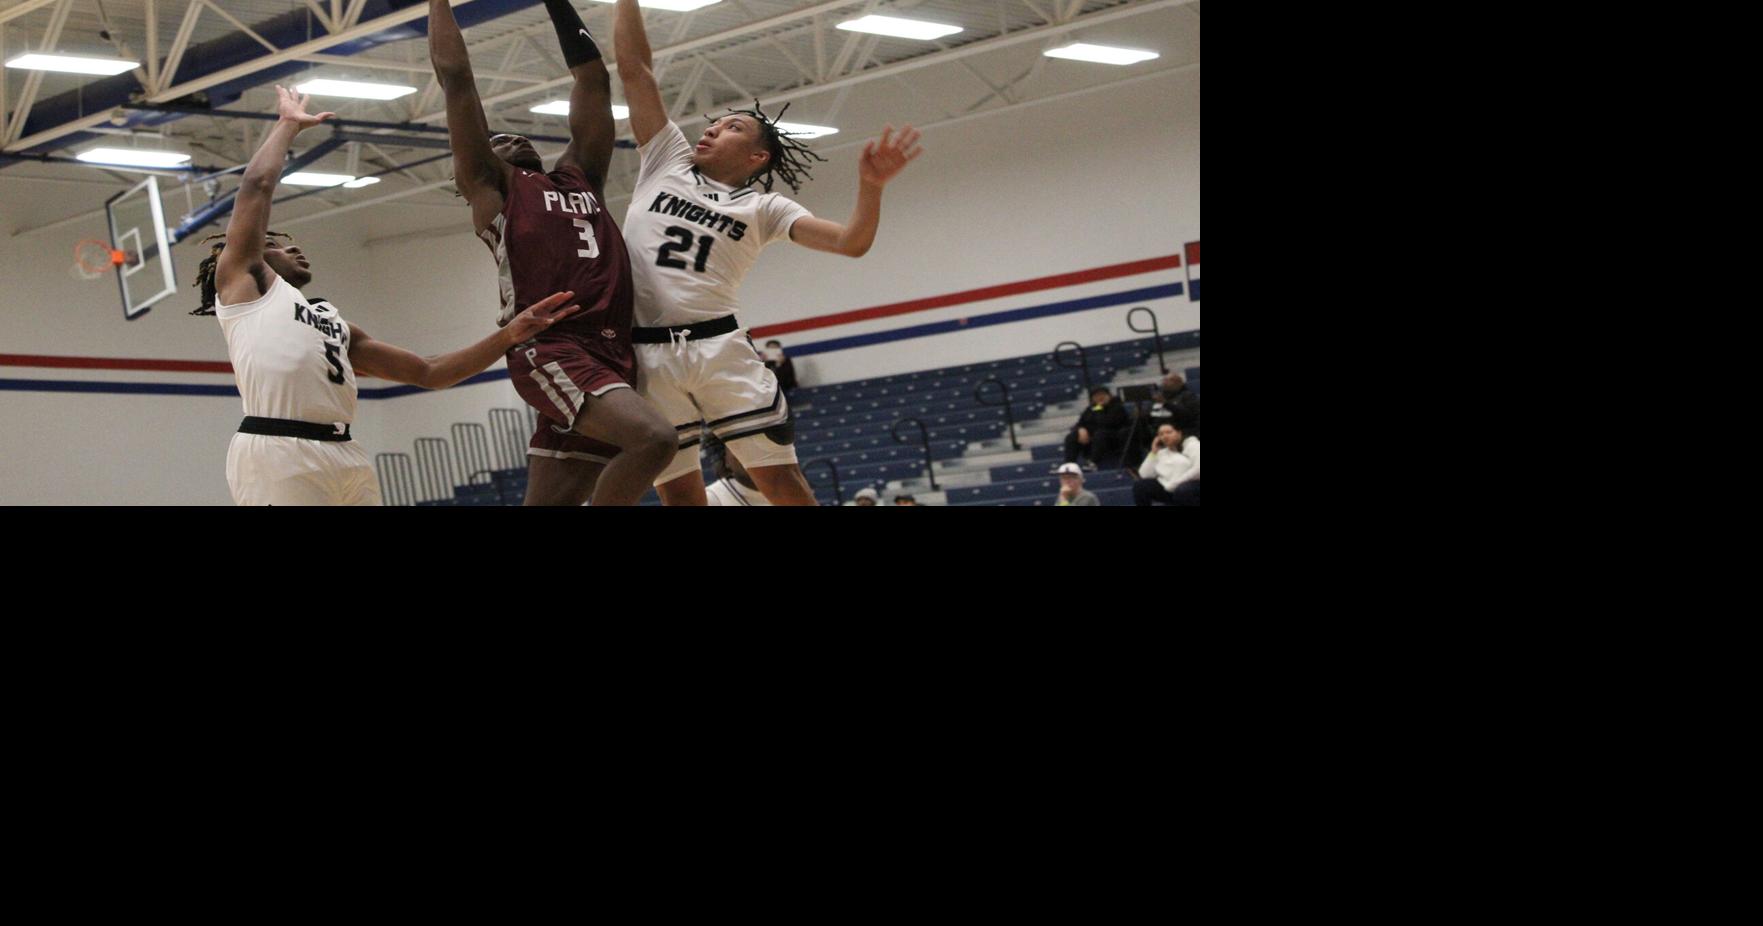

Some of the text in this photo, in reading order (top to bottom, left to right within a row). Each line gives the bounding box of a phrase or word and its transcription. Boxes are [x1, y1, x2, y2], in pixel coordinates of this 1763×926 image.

[573, 218, 600, 259] 3
[648, 192, 748, 241] KNIGHTS
[655, 225, 715, 273] 21
[324, 341, 345, 385] 5
[525, 347, 537, 368] P
